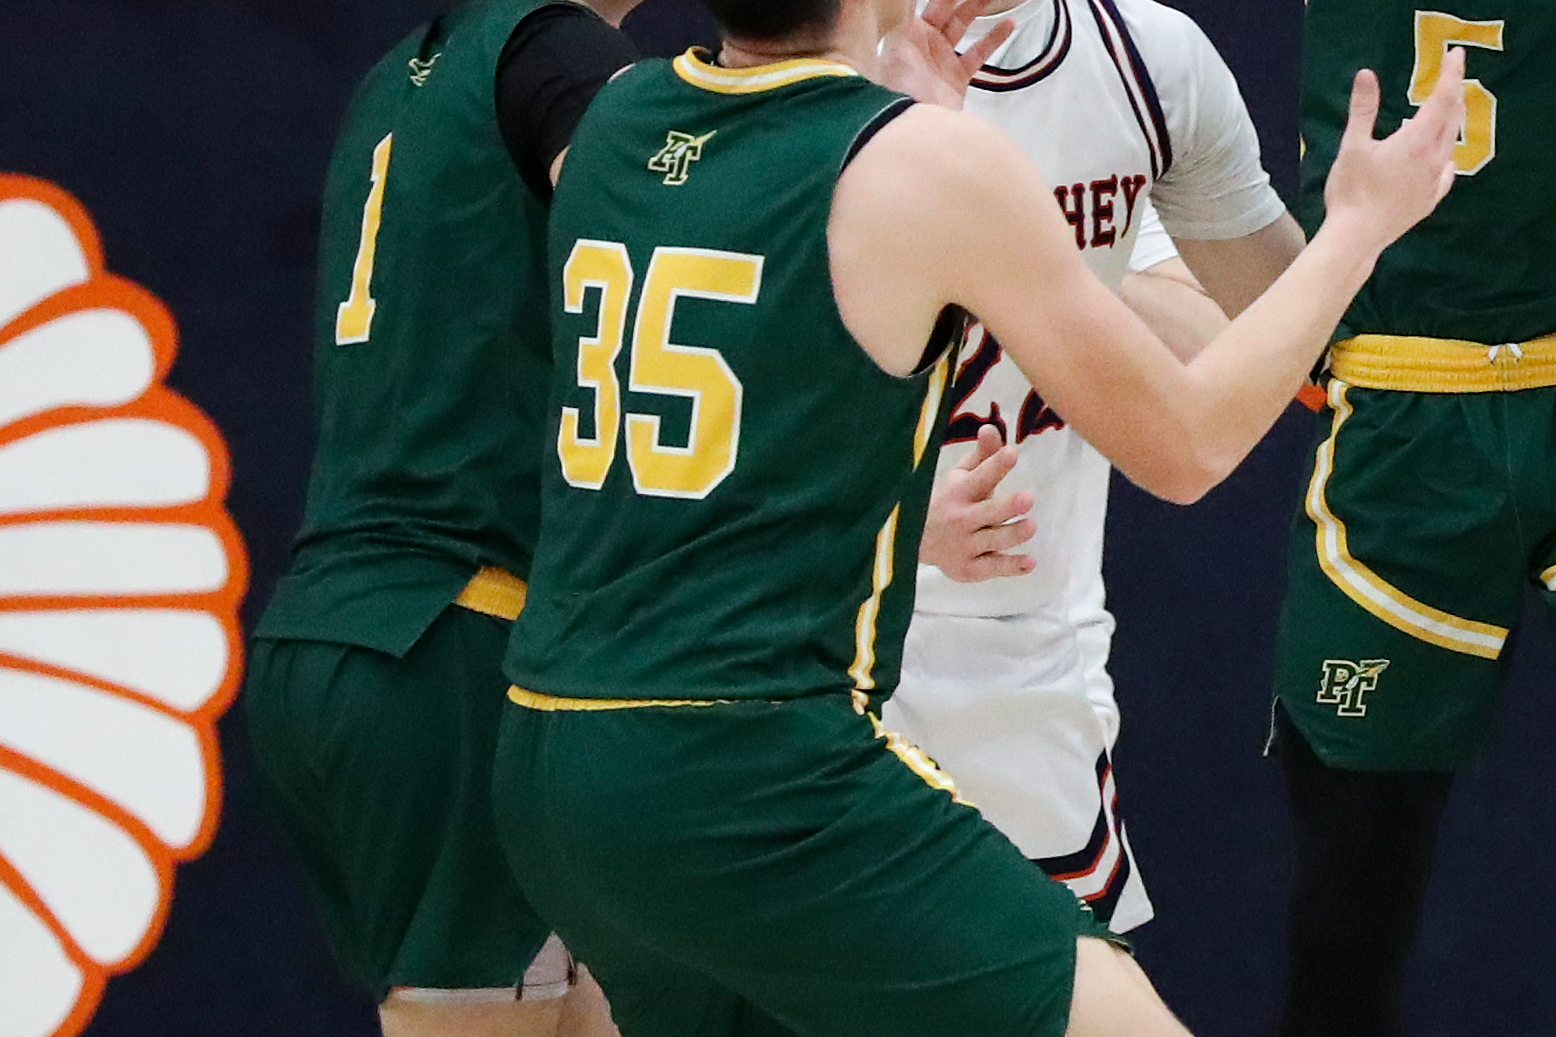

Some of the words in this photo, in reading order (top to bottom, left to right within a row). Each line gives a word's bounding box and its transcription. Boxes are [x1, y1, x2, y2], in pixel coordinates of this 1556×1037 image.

[1407, 10, 1504, 176] 5
[335, 131, 393, 346] 1
[557, 238, 766, 500] 35
